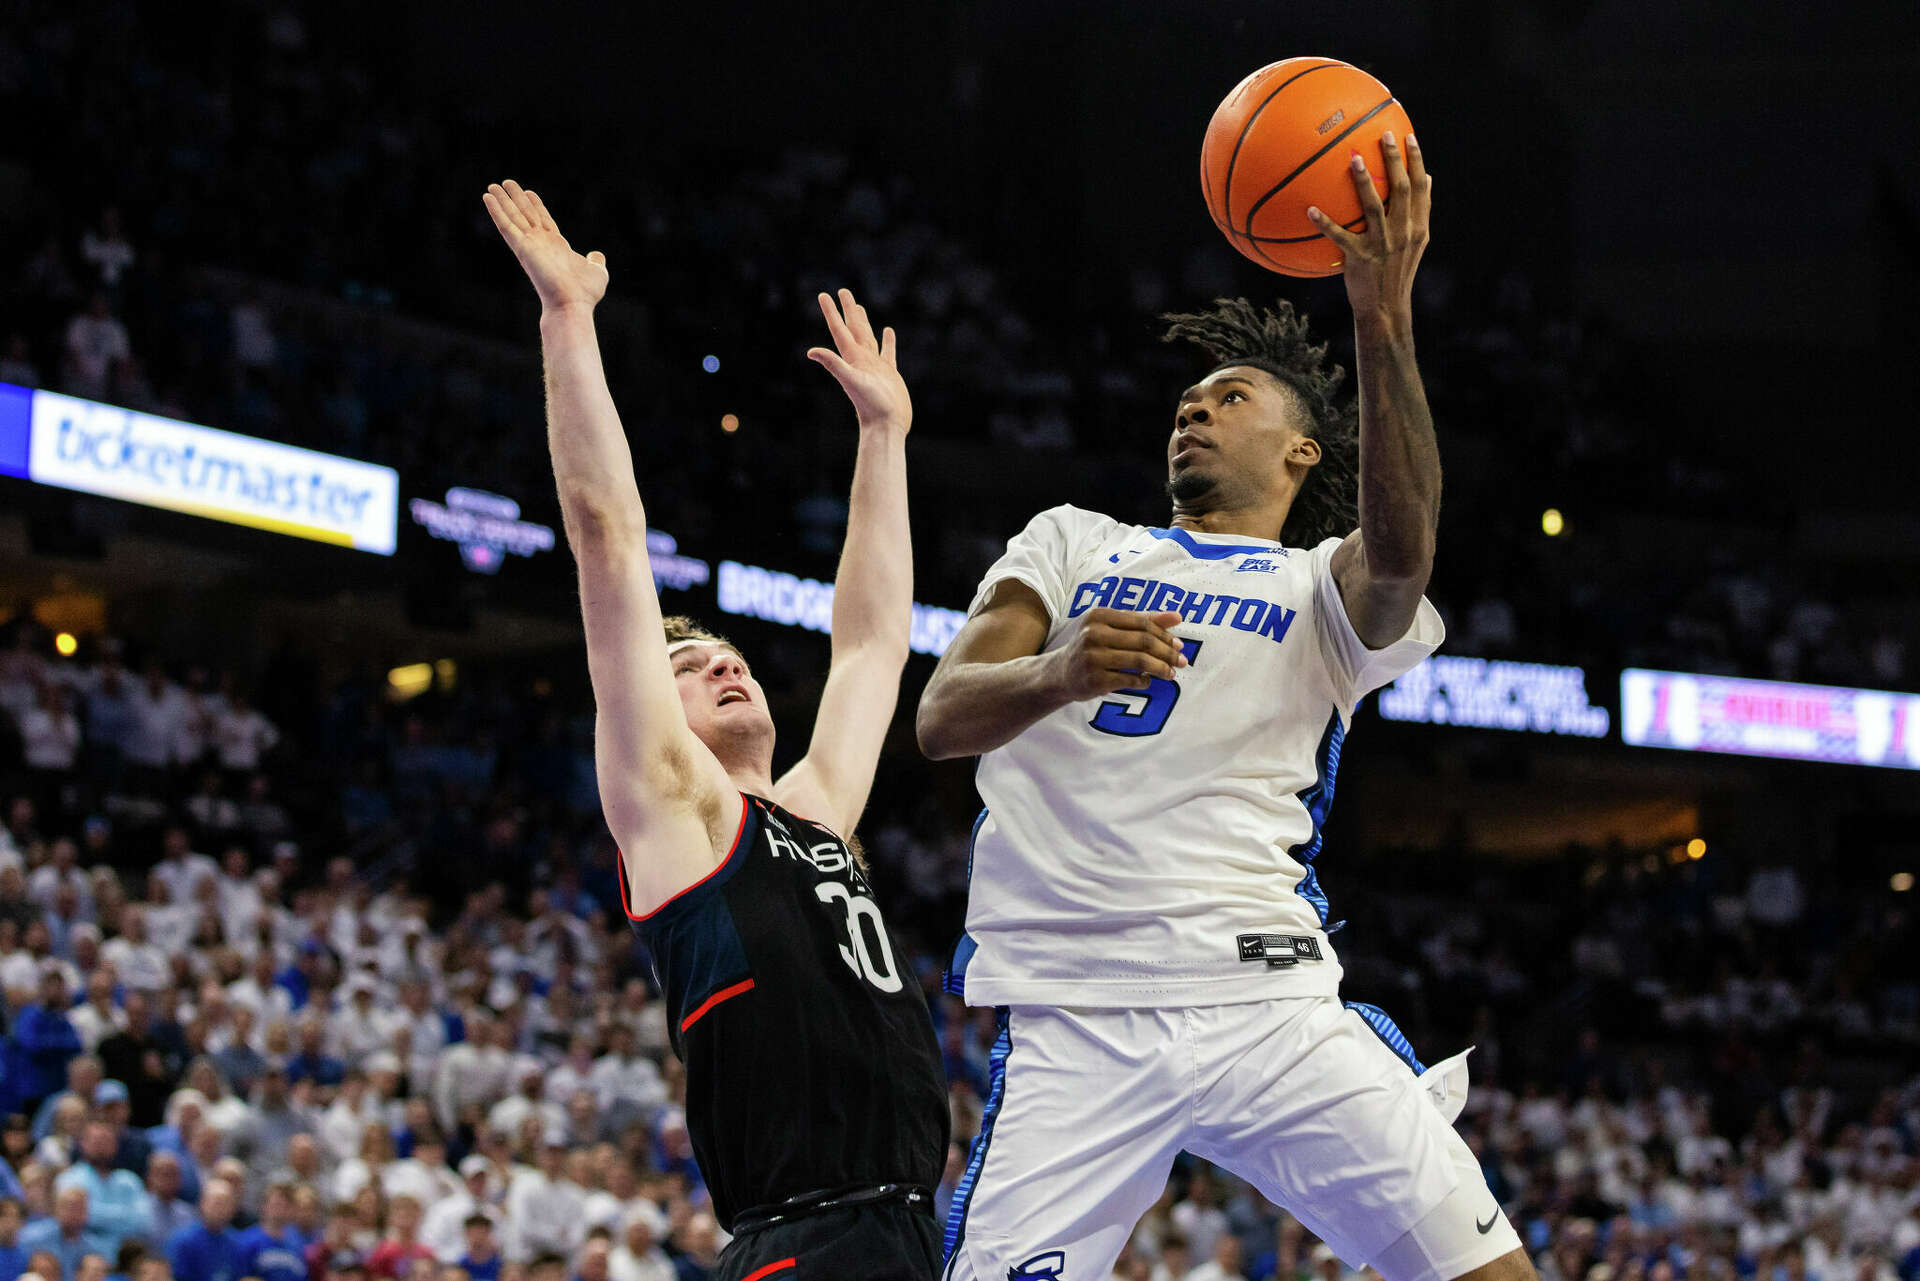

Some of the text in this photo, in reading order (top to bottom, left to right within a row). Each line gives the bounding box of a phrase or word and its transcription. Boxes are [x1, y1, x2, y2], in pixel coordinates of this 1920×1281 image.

[56, 412, 373, 523] ticketmaster
[1068, 576, 1297, 643] CREIGHTON
[1088, 637, 1203, 738] 5
[815, 881, 903, 993] 30
[1297, 942, 1310, 953] 46
